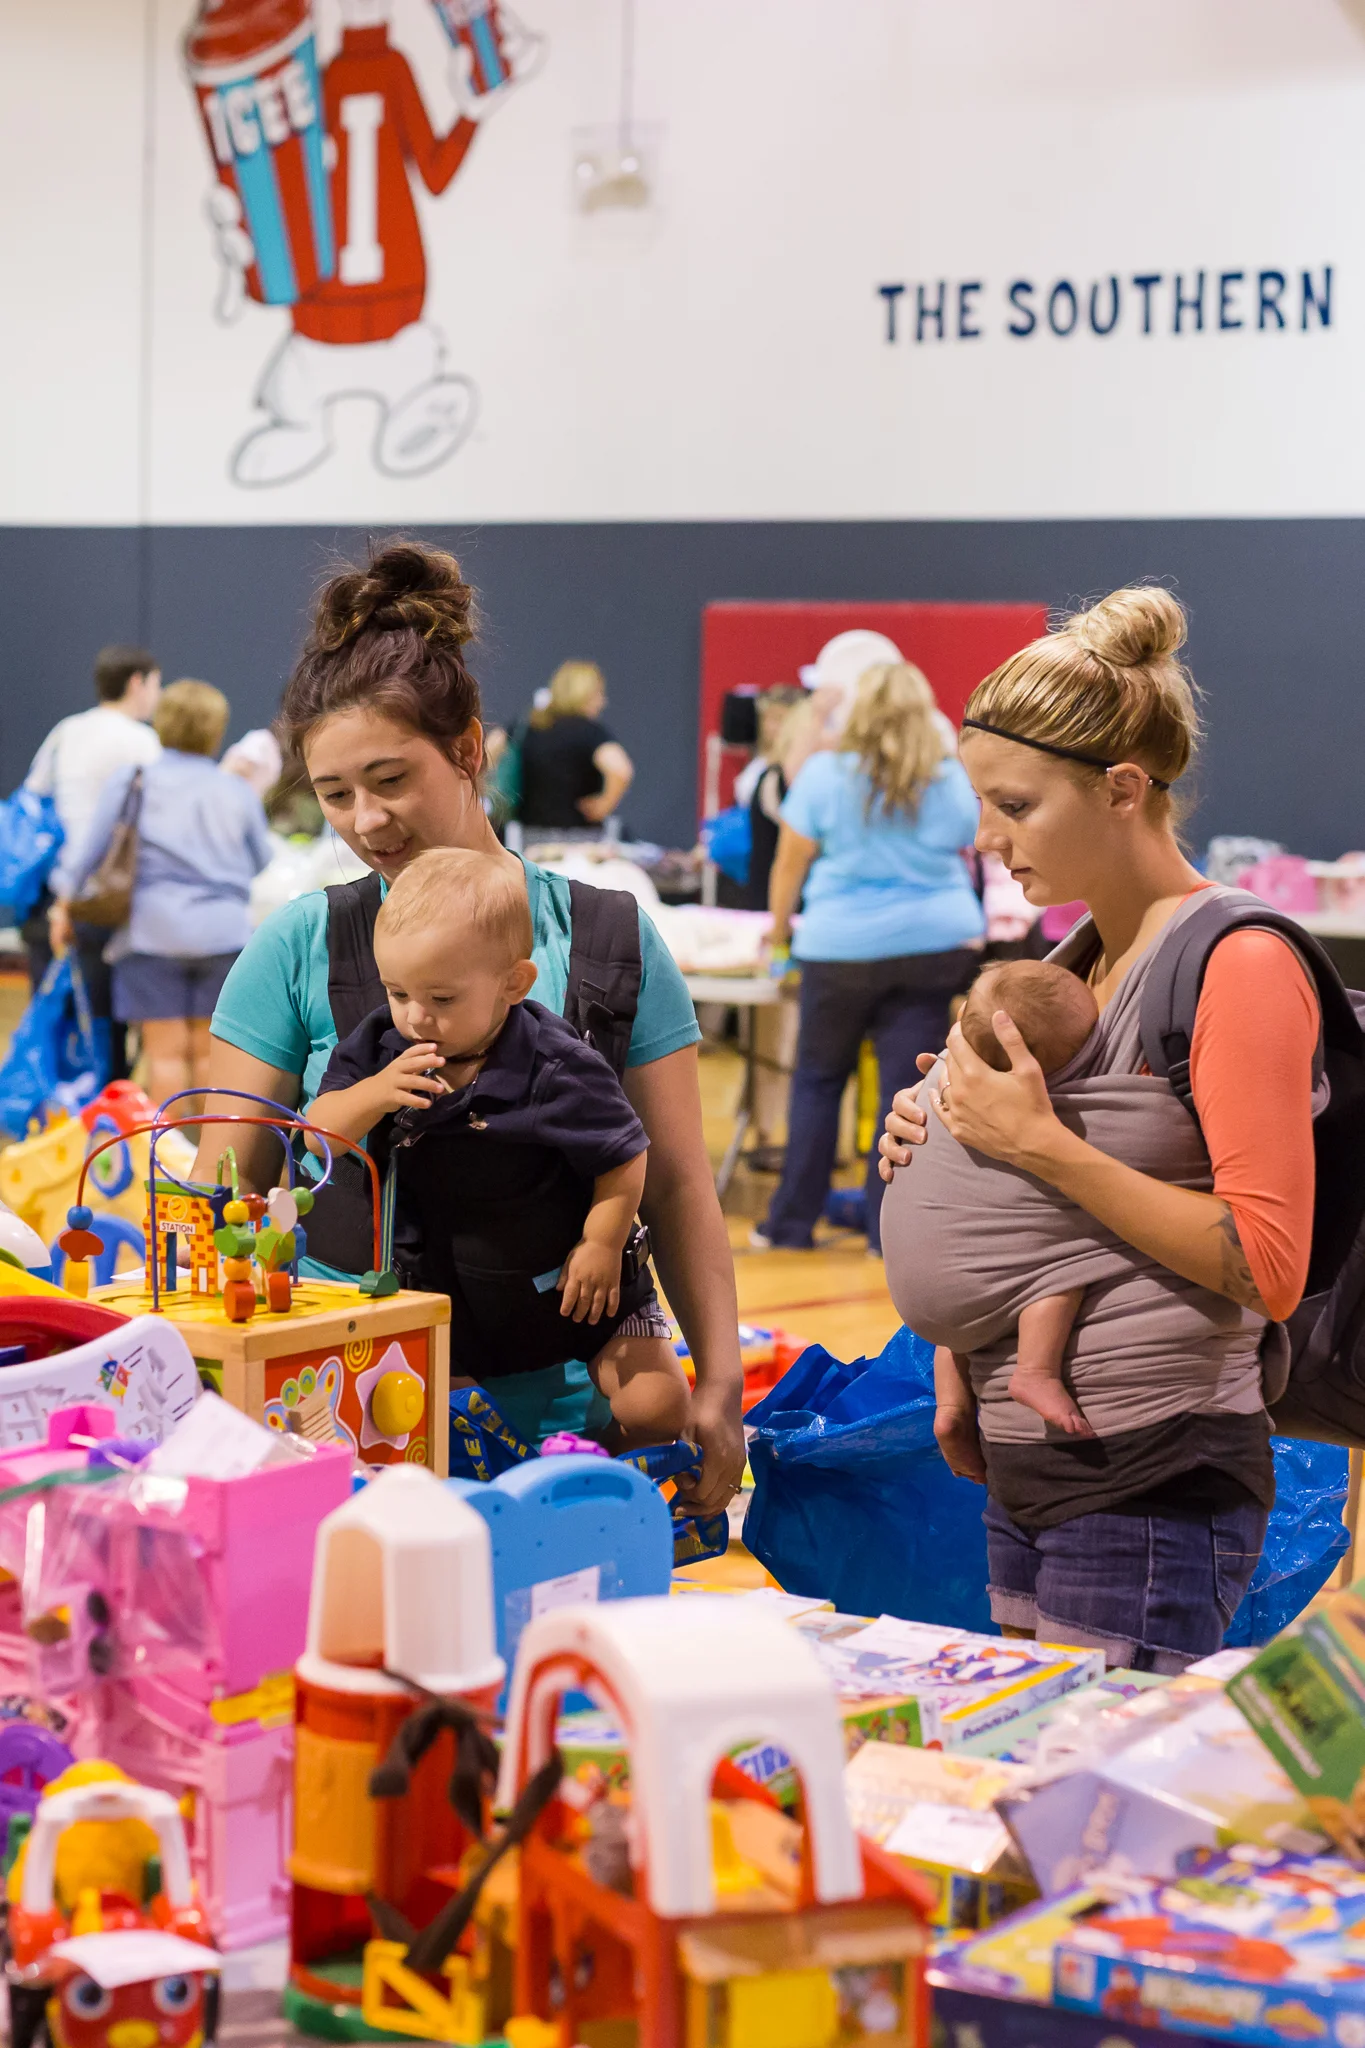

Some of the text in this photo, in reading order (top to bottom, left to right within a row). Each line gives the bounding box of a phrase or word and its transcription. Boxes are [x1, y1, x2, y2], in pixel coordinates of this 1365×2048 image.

[204, 60, 317, 163] ICEE
[877, 265, 1333, 344] THE SOUTHERN
[161, 1222, 193, 1232] STATION
[452, 1416, 492, 1481] KEA
[467, 1390, 528, 1457] IKEA
